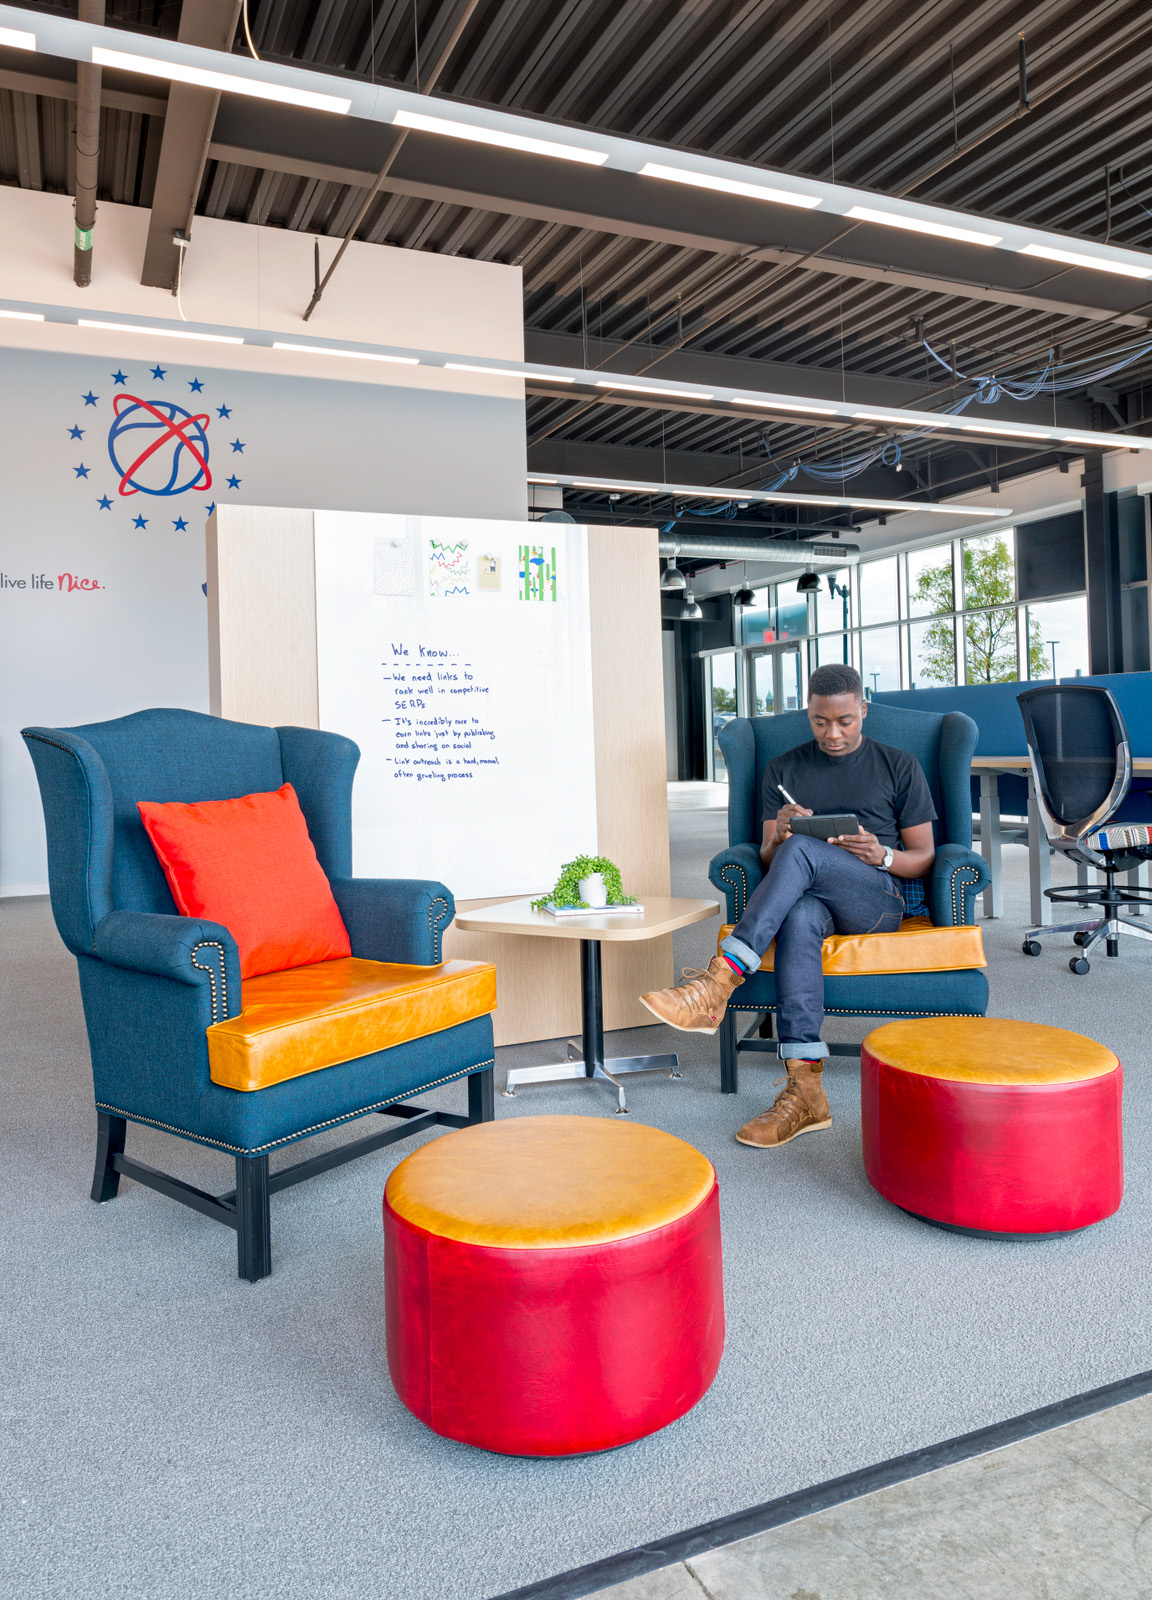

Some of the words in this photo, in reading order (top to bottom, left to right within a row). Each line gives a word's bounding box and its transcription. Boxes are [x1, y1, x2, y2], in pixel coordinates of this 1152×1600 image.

[0, 572, 27, 589] live
[31, 573, 54, 590] life
[392, 643, 408, 656] We
[393, 673, 405, 681] We
[412, 672, 432, 681] need
[438, 672, 458, 680] links
[464, 672, 473, 680] to
[395, 687, 413, 695] rank
[418, 686, 433, 694] well
[450, 686, 488, 695] competitive
[395, 699, 425, 709] SERPs
[395, 718, 412, 726] It's
[417, 717, 452, 727] incredibly
[434, 730, 448, 738] just
[453, 730, 461, 739] by
[464, 729, 495, 740] publishing
[412, 741, 438, 751] sharing
[453, 741, 472, 749] social
[394, 757, 410, 765] Link
[394, 769, 413, 778] often
[417, 771, 446, 782] grueling
[447, 772, 472, 780] process
